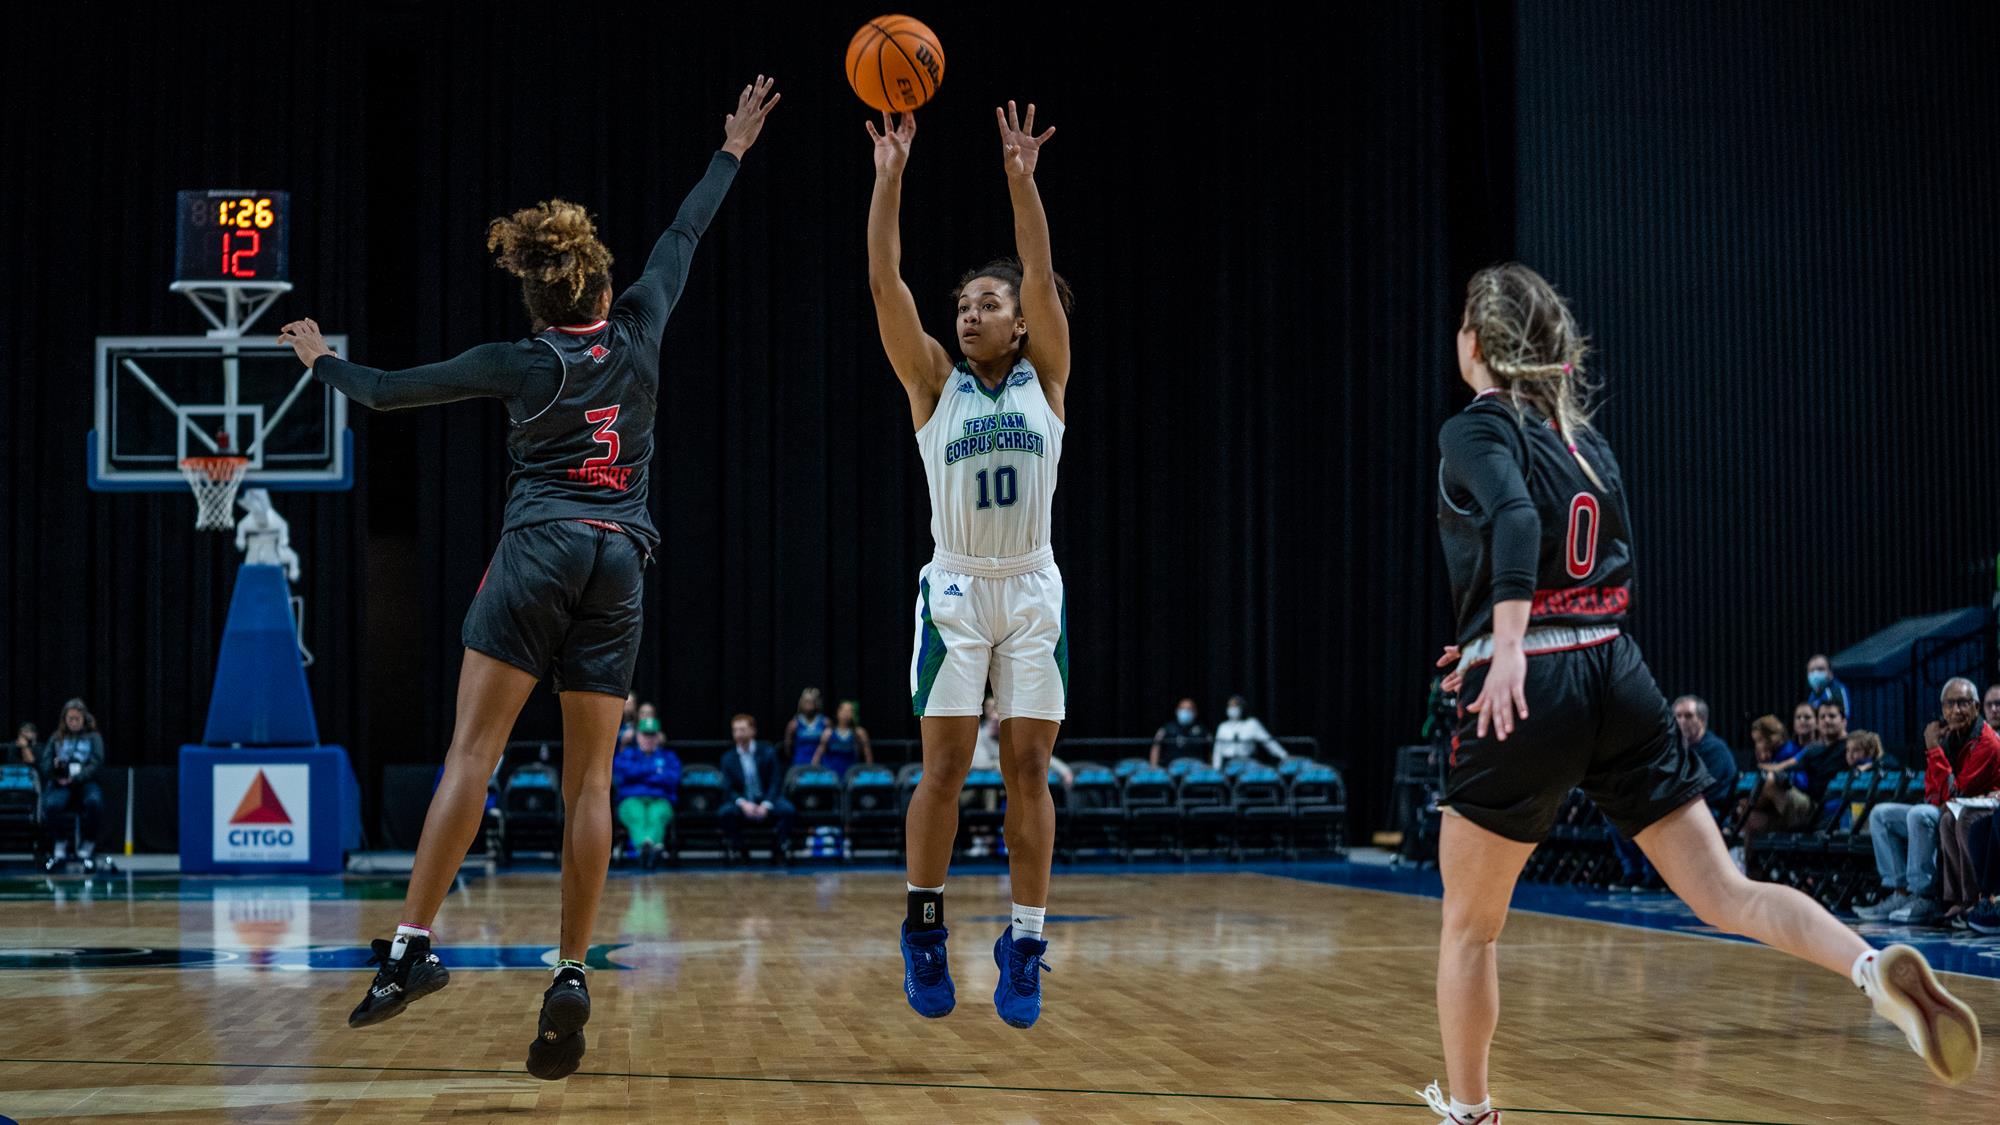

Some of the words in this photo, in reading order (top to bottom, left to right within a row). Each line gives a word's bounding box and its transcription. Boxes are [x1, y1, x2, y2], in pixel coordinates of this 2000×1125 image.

[219, 198, 274, 228] 1:26
[222, 230, 260, 277] 12
[584, 404, 620, 468] 3
[1001, 413, 1025, 429] A&M
[946, 434, 993, 464] CORPUS
[976, 465, 1018, 510] 10
[1566, 491, 1600, 580] 0
[228, 829, 294, 846] CITGO
